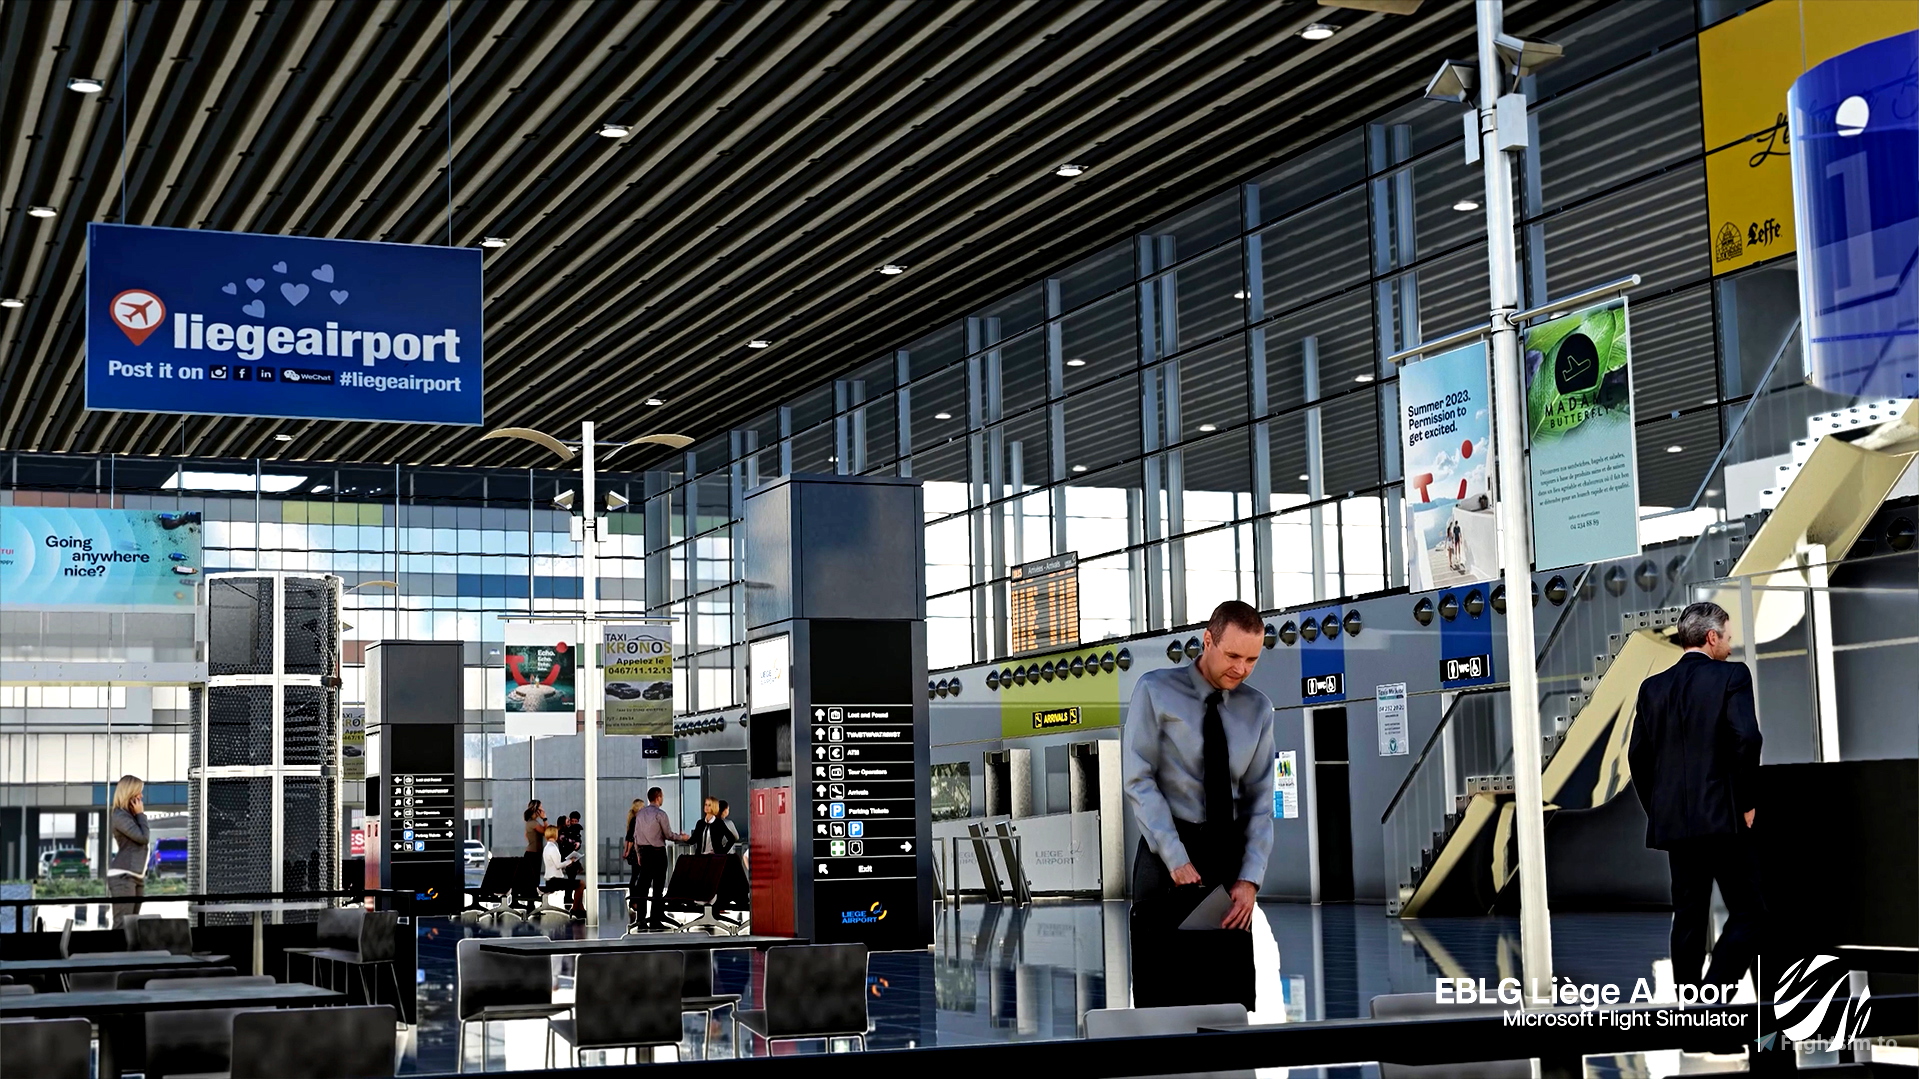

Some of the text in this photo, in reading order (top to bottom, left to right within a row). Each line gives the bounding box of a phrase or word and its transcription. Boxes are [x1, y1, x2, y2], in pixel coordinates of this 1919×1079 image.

[1746, 217, 1781, 247] Leffe
[173, 312, 461, 367] liegeairport
[108, 359, 153, 378] Post
[158, 362, 173, 379] it
[178, 366, 203, 380] on
[301, 373, 332, 382] WeChat
[339, 371, 462, 394] #liegeairport
[1408, 389, 1471, 418] Summer 2023.
[1408, 406, 1467, 431] Permission to
[1550, 404, 1609, 429] BUTTERFLY
[1409, 420, 1458, 447] get excited.
[45, 535, 93, 552] Going
[72, 550, 150, 566] anywhere
[64, 565, 106, 577] nice?
[605, 633, 627, 642] TAXI
[606, 642, 672, 654] KRONOS
[616, 657, 664, 666] Appelez le
[1459, 663, 1470, 673] WC
[608, 667, 672, 675] 0467/11.12.13
[1043, 711, 1069, 724] ARRIVALS
[860, 768, 888, 776] Operators
[858, 865, 873, 873] Exit
